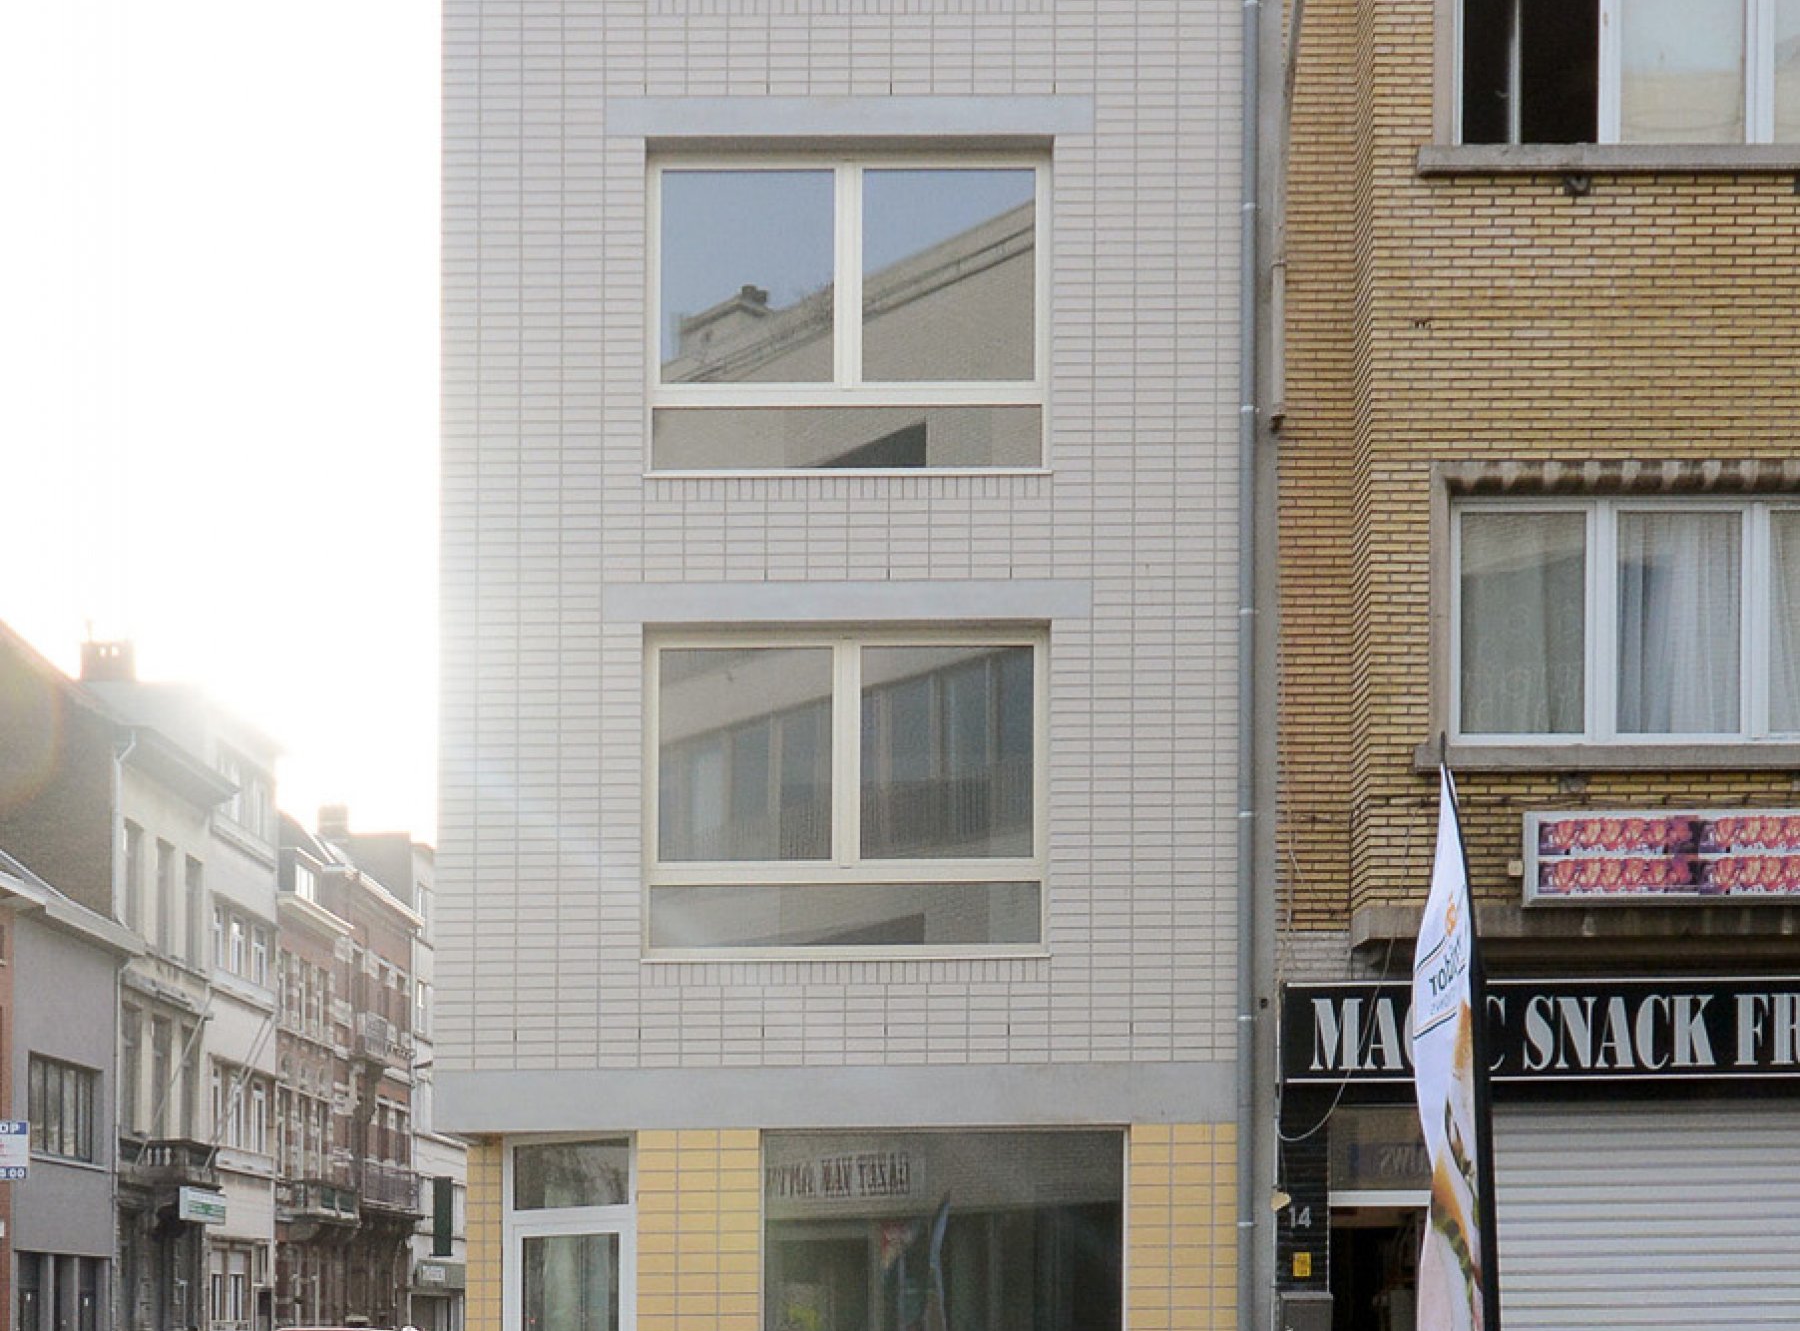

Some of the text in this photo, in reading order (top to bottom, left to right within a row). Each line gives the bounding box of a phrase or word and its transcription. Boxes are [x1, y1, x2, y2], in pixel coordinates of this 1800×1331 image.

[1309, 995, 1506, 1071] MAC
[1523, 994, 1716, 1070] SNACK
[1288, 1205, 1312, 1229] 14
